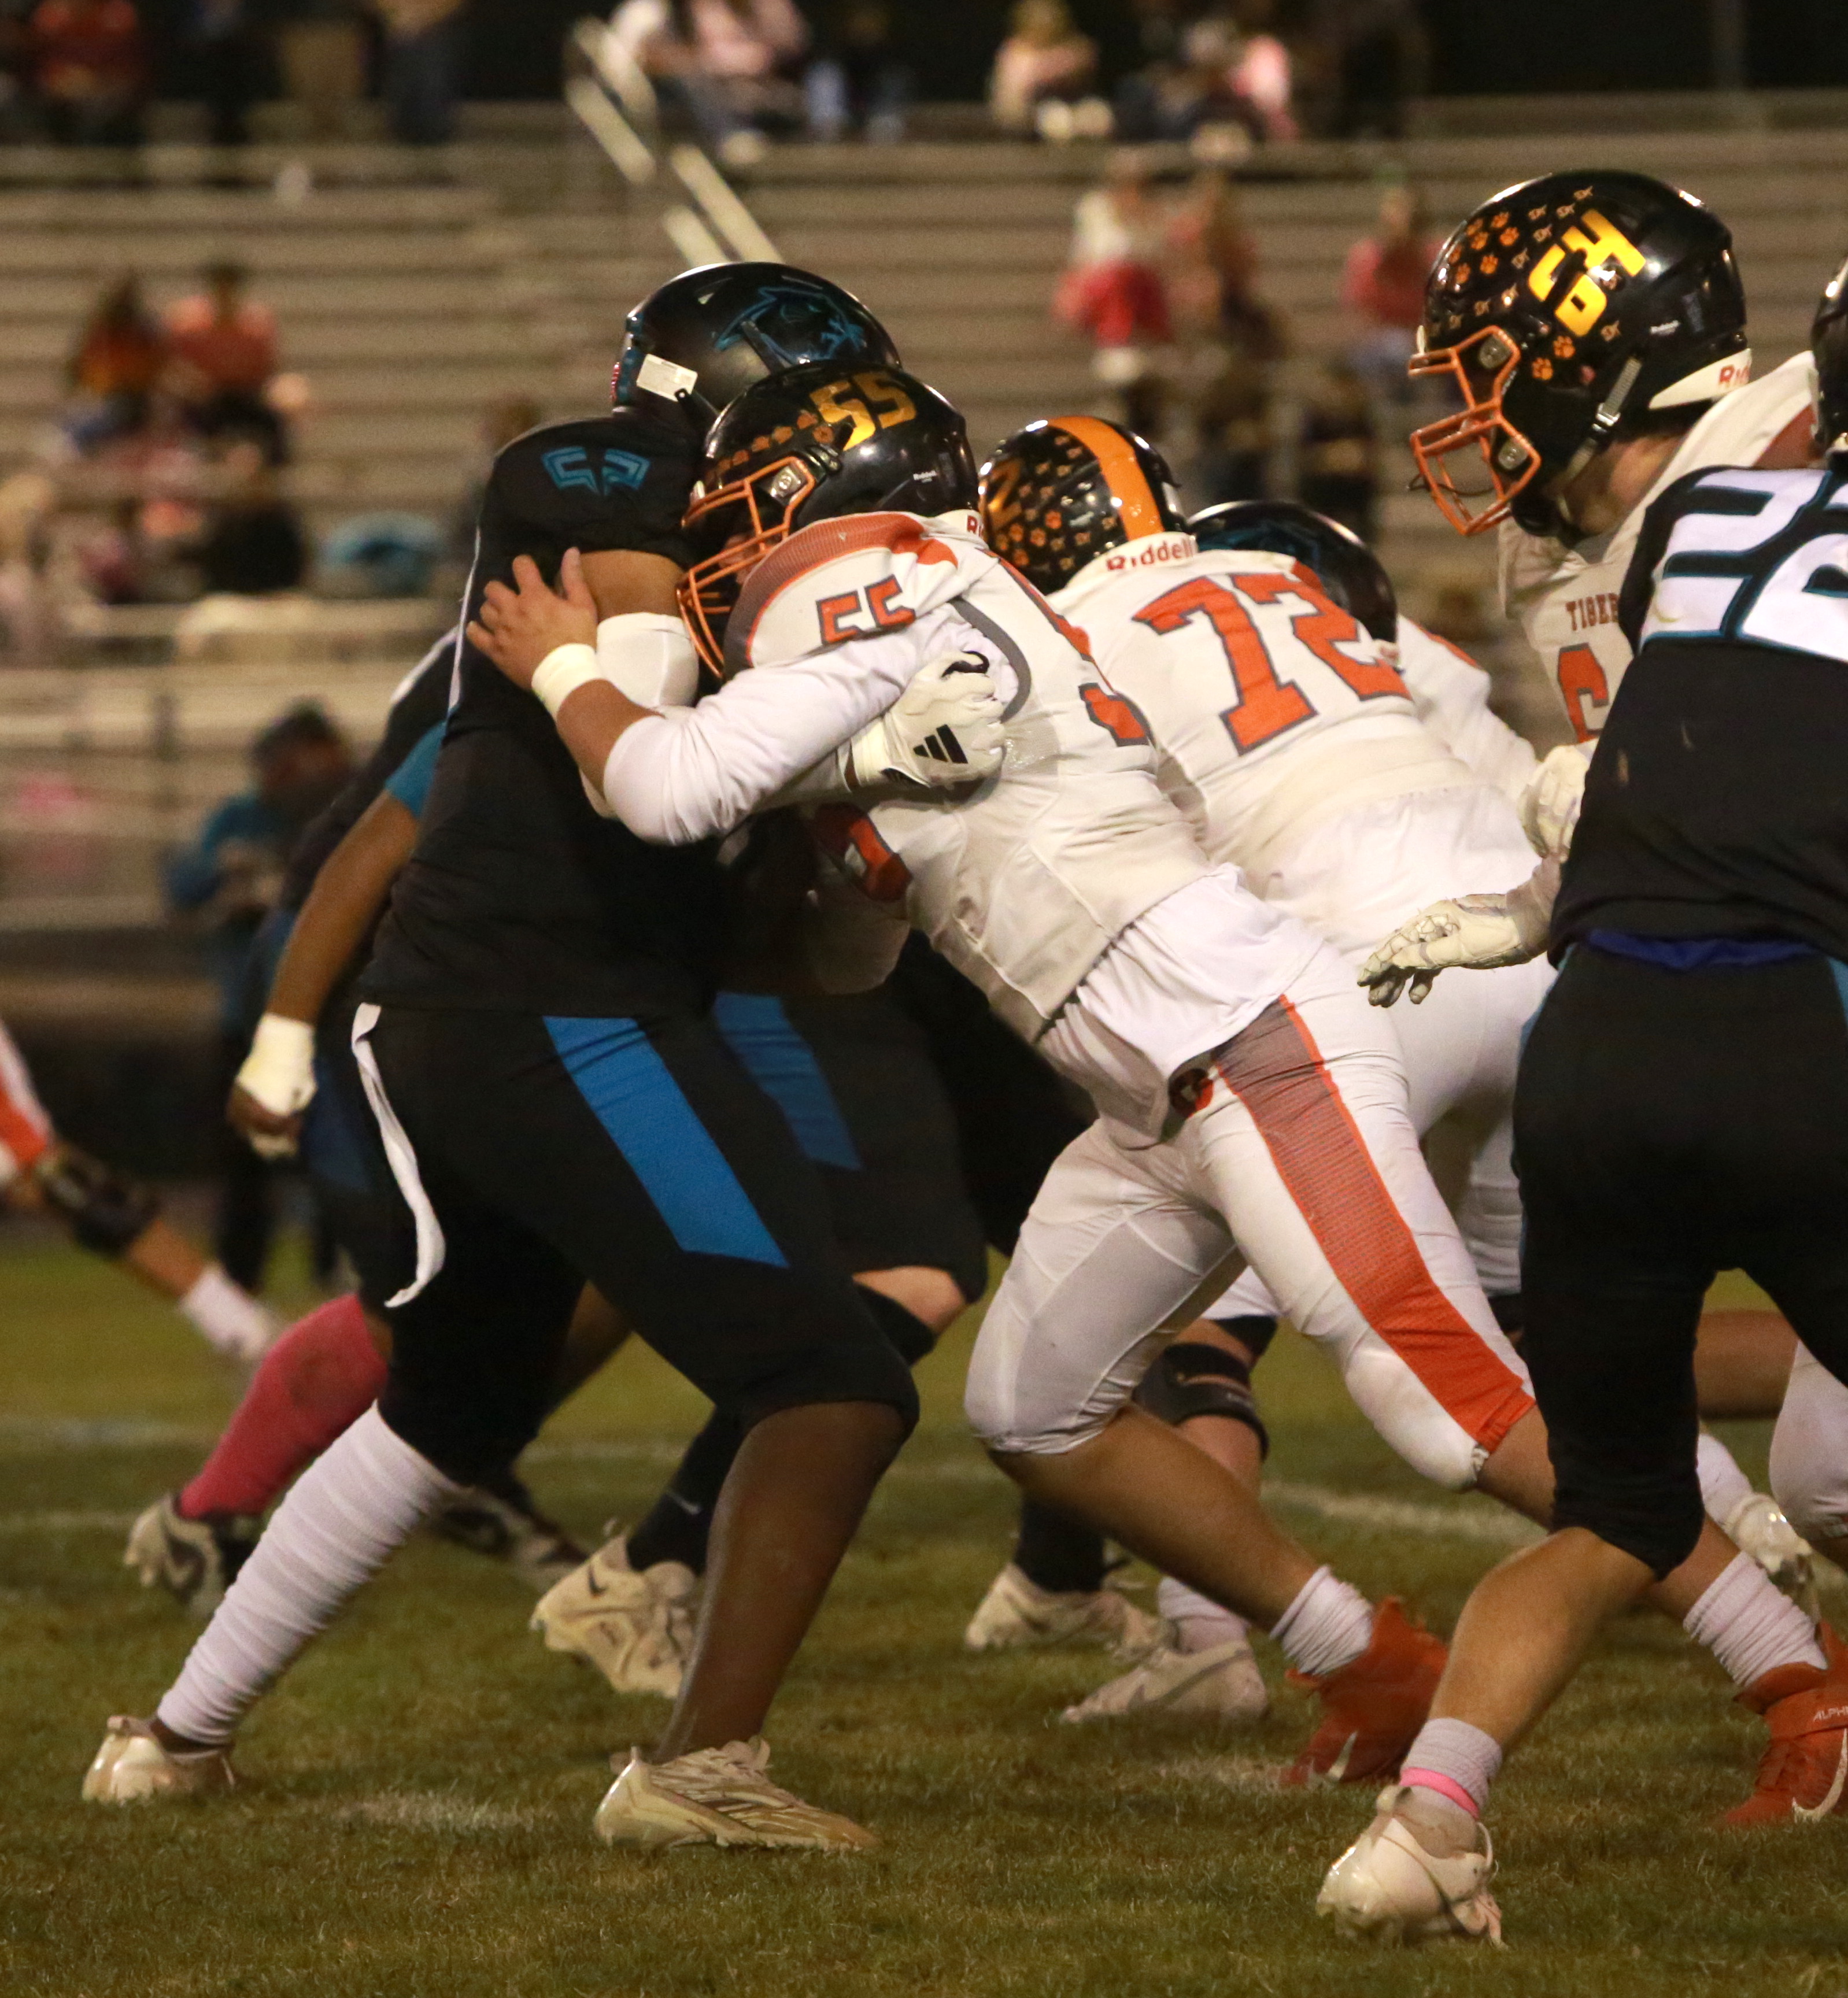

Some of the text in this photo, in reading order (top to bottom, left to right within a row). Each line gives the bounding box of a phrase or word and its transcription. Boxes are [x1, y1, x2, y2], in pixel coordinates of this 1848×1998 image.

[1528, 209, 1646, 336] 64
[810, 372, 916, 452] 55
[1132, 572, 1413, 756] 72
[1813, 1705, 1848, 1722] ALPH
